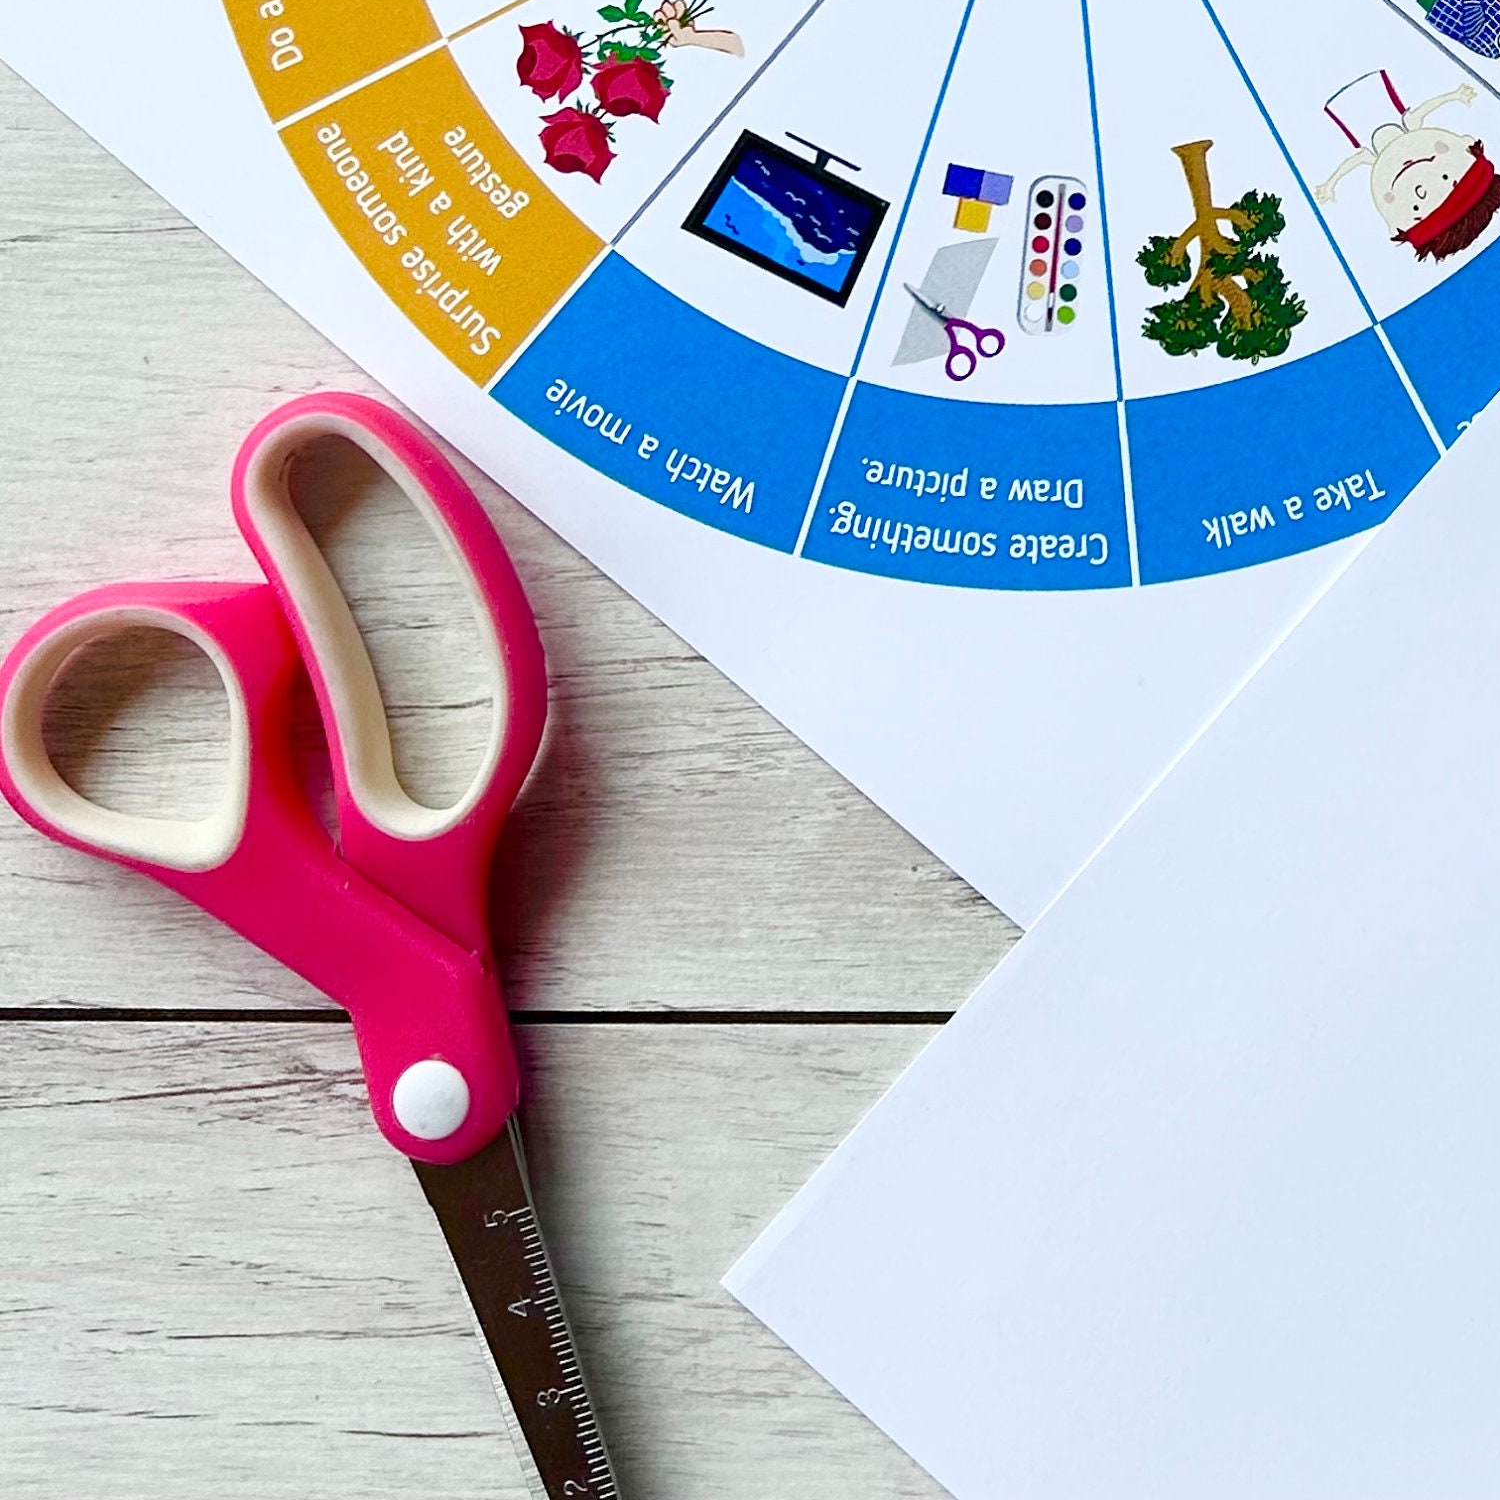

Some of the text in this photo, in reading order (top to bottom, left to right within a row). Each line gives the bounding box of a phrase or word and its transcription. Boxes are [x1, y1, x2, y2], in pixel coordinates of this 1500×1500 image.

[271, 26, 304, 73] Do
[376, 129, 503, 276] with a kind
[442, 125, 530, 221] gesture
[316, 122, 502, 356] Surprise someone
[545, 378, 755, 514] Watch a movie
[861, 457, 1083, 509] Draw a picture.
[1201, 469, 1387, 550] Take a walk
[828, 502, 1108, 566] Create something.
[483, 1210, 509, 1228] 5
[507, 1296, 533, 1317] 4
[537, 1388, 561, 1406] 3
